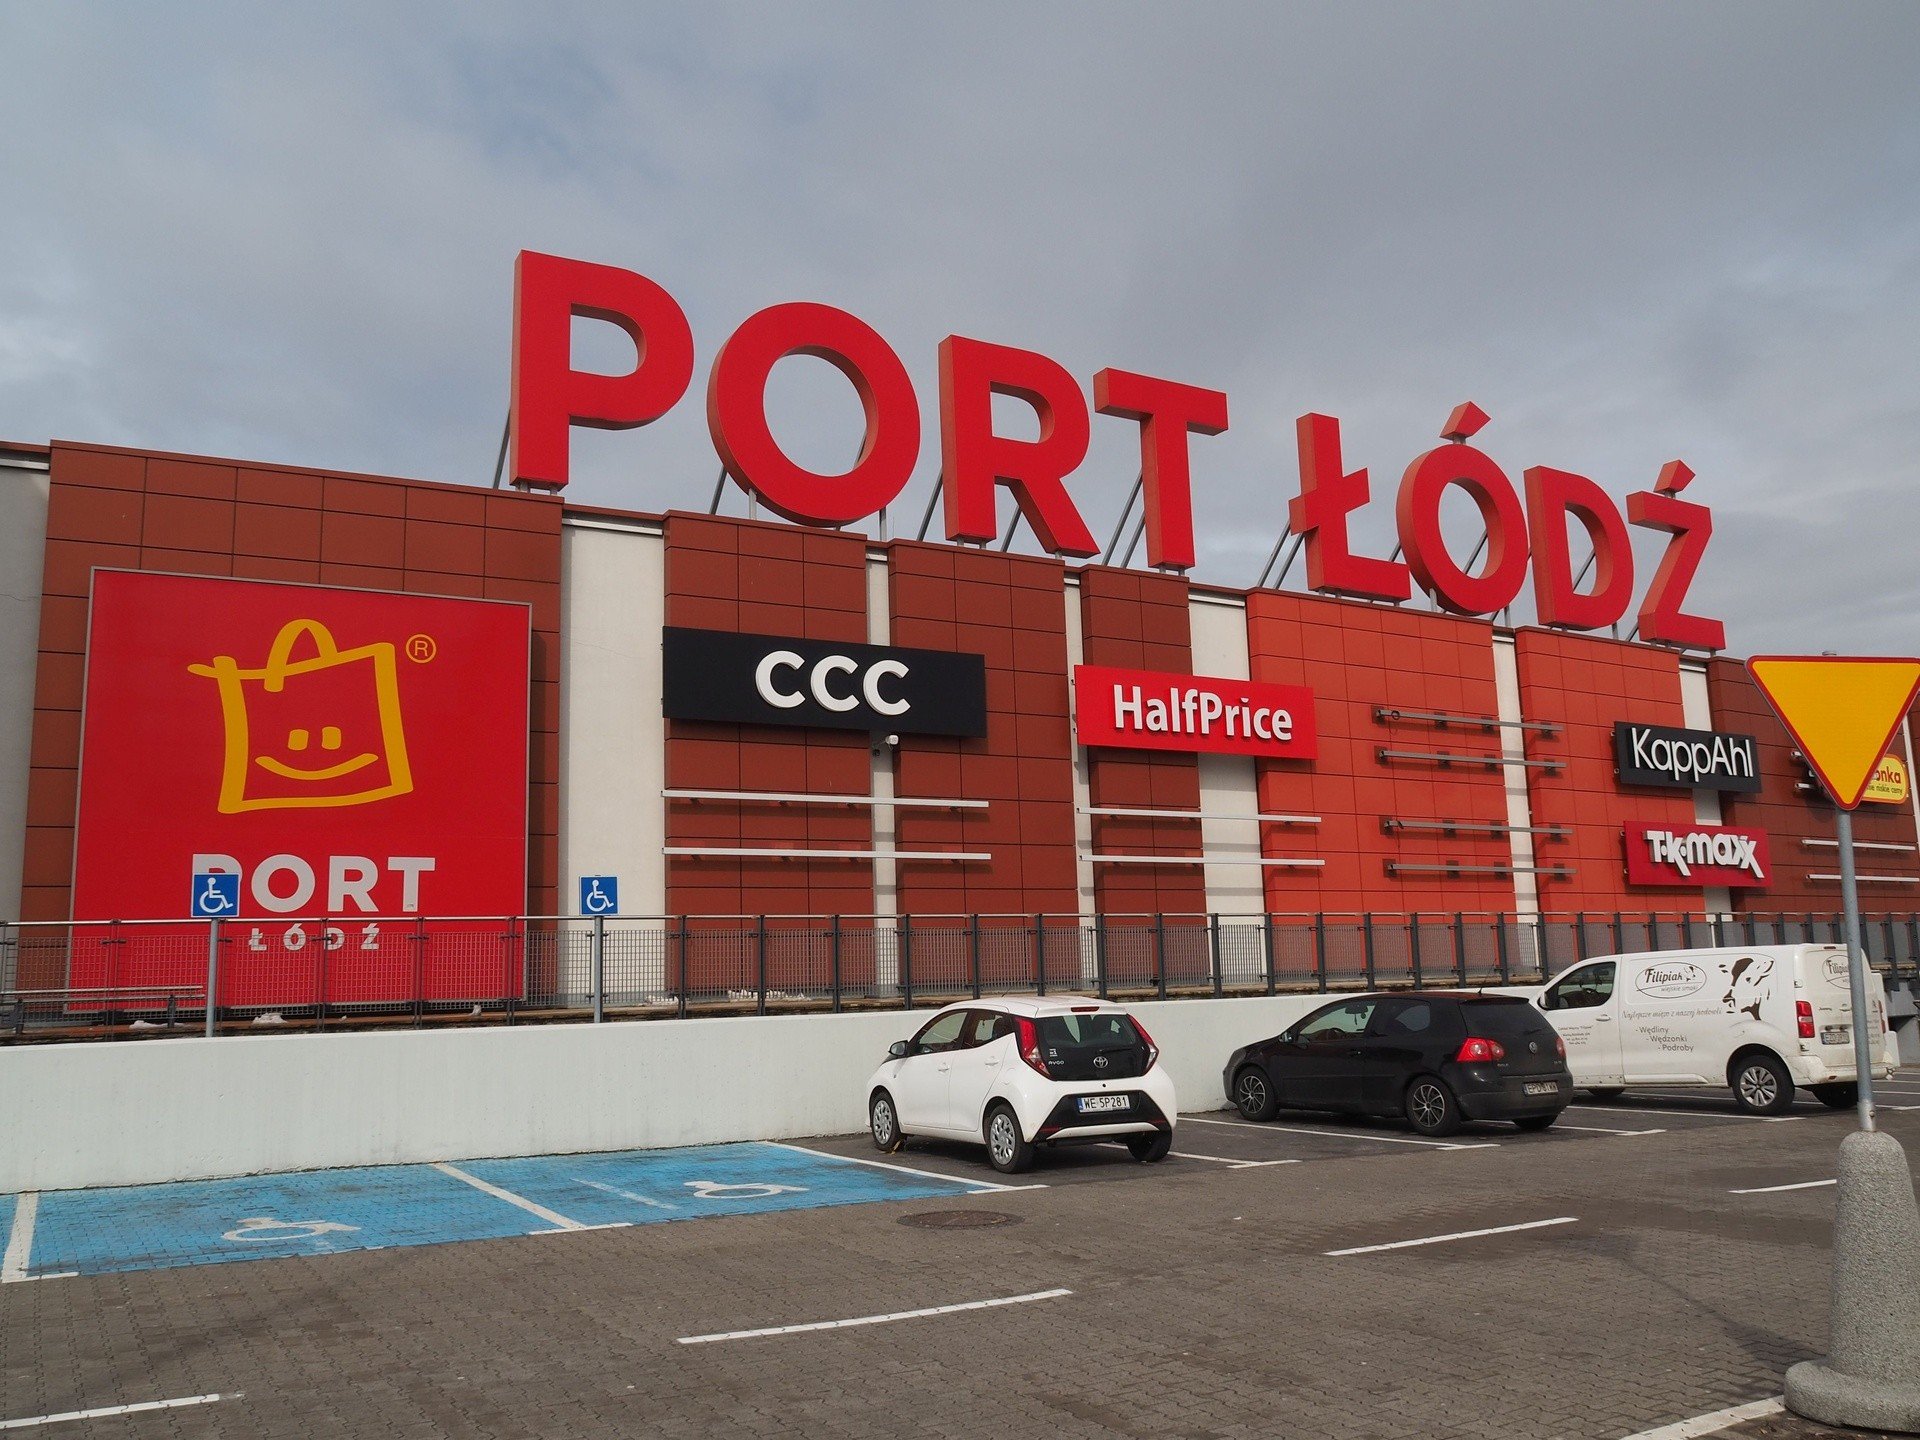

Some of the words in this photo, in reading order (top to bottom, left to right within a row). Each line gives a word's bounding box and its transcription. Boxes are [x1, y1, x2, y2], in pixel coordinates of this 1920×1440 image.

[509, 248, 1229, 569] PORT
[1288, 400, 1726, 651] ŁÓDŹ
[755, 650, 911, 716] CCC
[1113, 683, 1293, 741] HalfPrice
[1630, 727, 1754, 782] KappAhl
[248, 922, 380, 951] ŁÓDŹ
[1644, 968, 1683, 984] Filipiak
[1662, 1044, 1694, 1052] Podroby
[1083, 1097, 1098, 1109] WE
